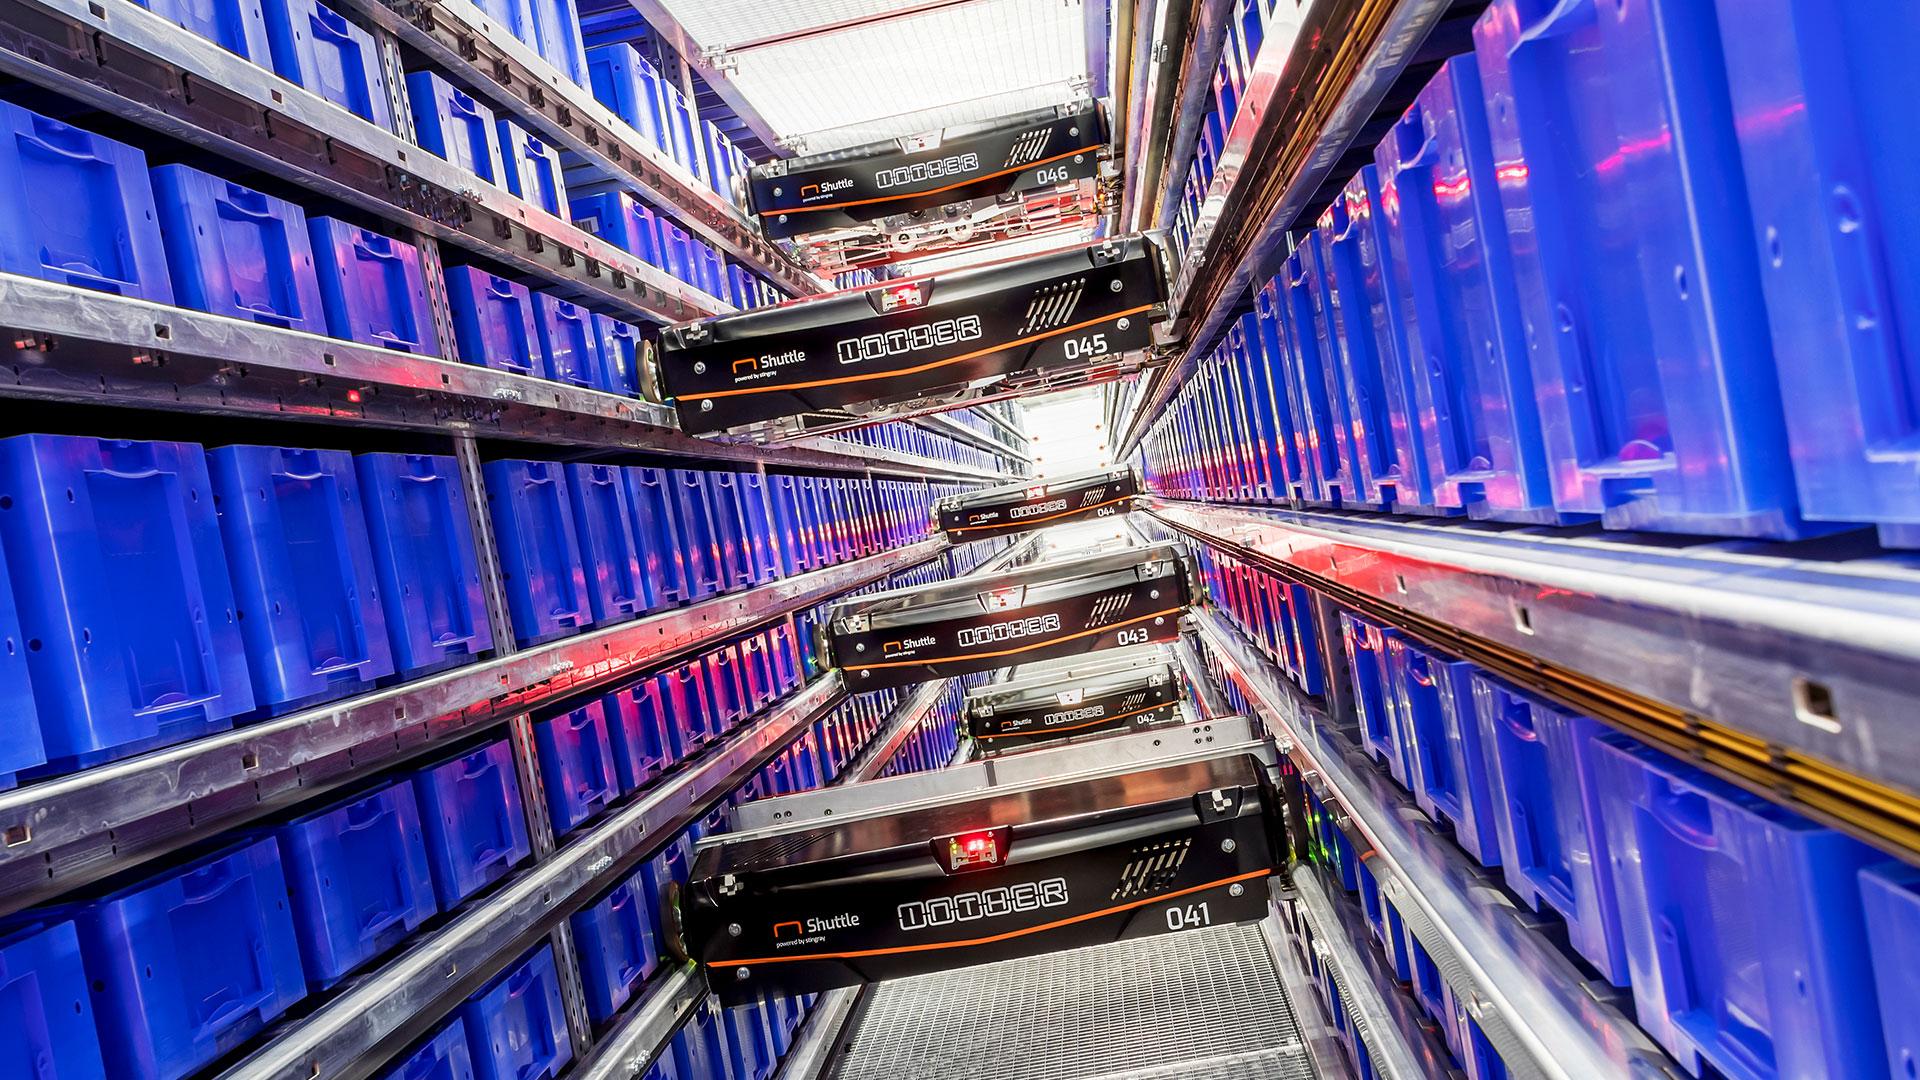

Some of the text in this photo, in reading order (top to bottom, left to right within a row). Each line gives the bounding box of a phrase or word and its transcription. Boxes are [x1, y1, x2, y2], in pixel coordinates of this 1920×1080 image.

[1036, 166, 1069, 185] 046
[821, 178, 854, 193] Shuttle
[1063, 333, 1108, 360] 045
[760, 349, 806, 369] Shuttle
[1097, 506, 1115, 518] 044
[903, 635, 936, 649] Shuttle
[1117, 627, 1149, 646] 043
[1137, 713, 1156, 725] 042
[806, 912, 860, 933] Shuttle
[1165, 901, 1211, 931] 041
[776, 935, 826, 949] powered by stingray
